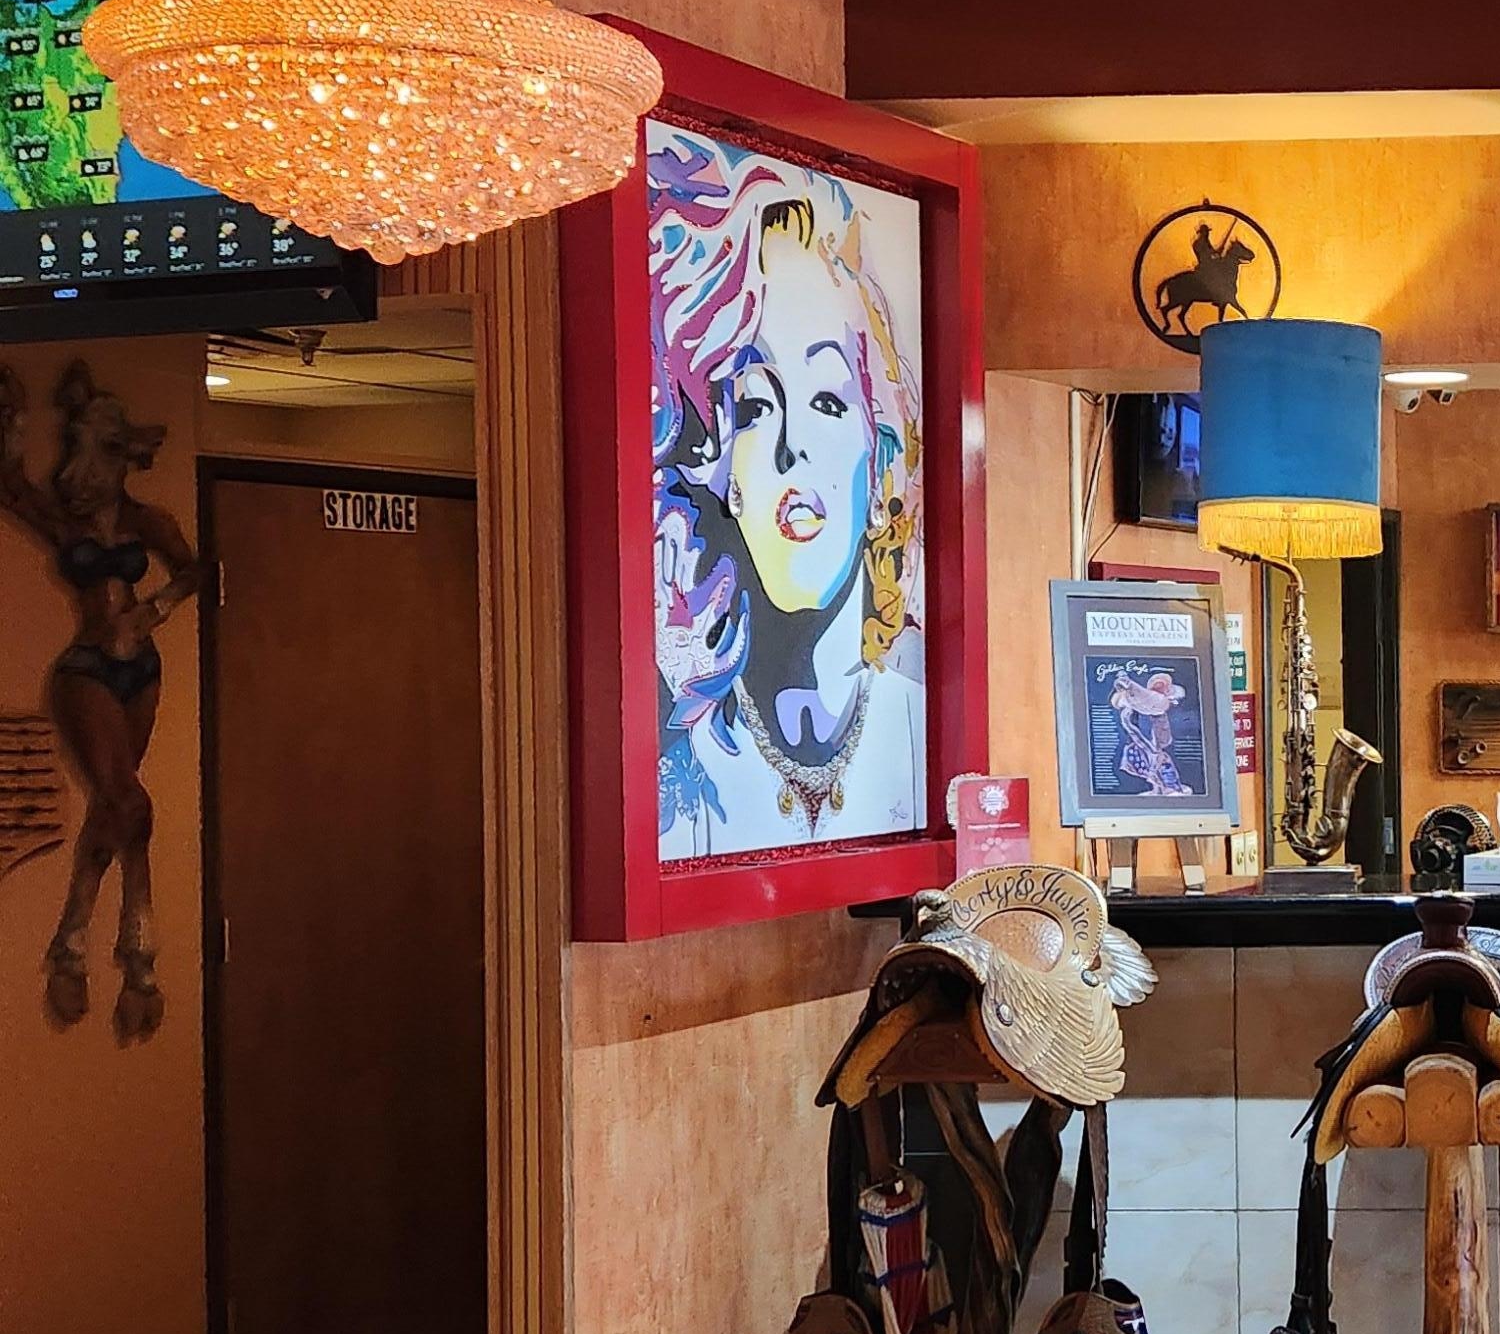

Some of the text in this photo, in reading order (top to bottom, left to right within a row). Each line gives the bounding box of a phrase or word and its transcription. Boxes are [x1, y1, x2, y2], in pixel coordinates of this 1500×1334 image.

[325, 491, 416, 531] STORAGE
[1091, 616, 1188, 632] MOUNTAIN
[1138, 632, 1188, 640] MAGAZINE
[1031, 872, 1091, 955] Justice
